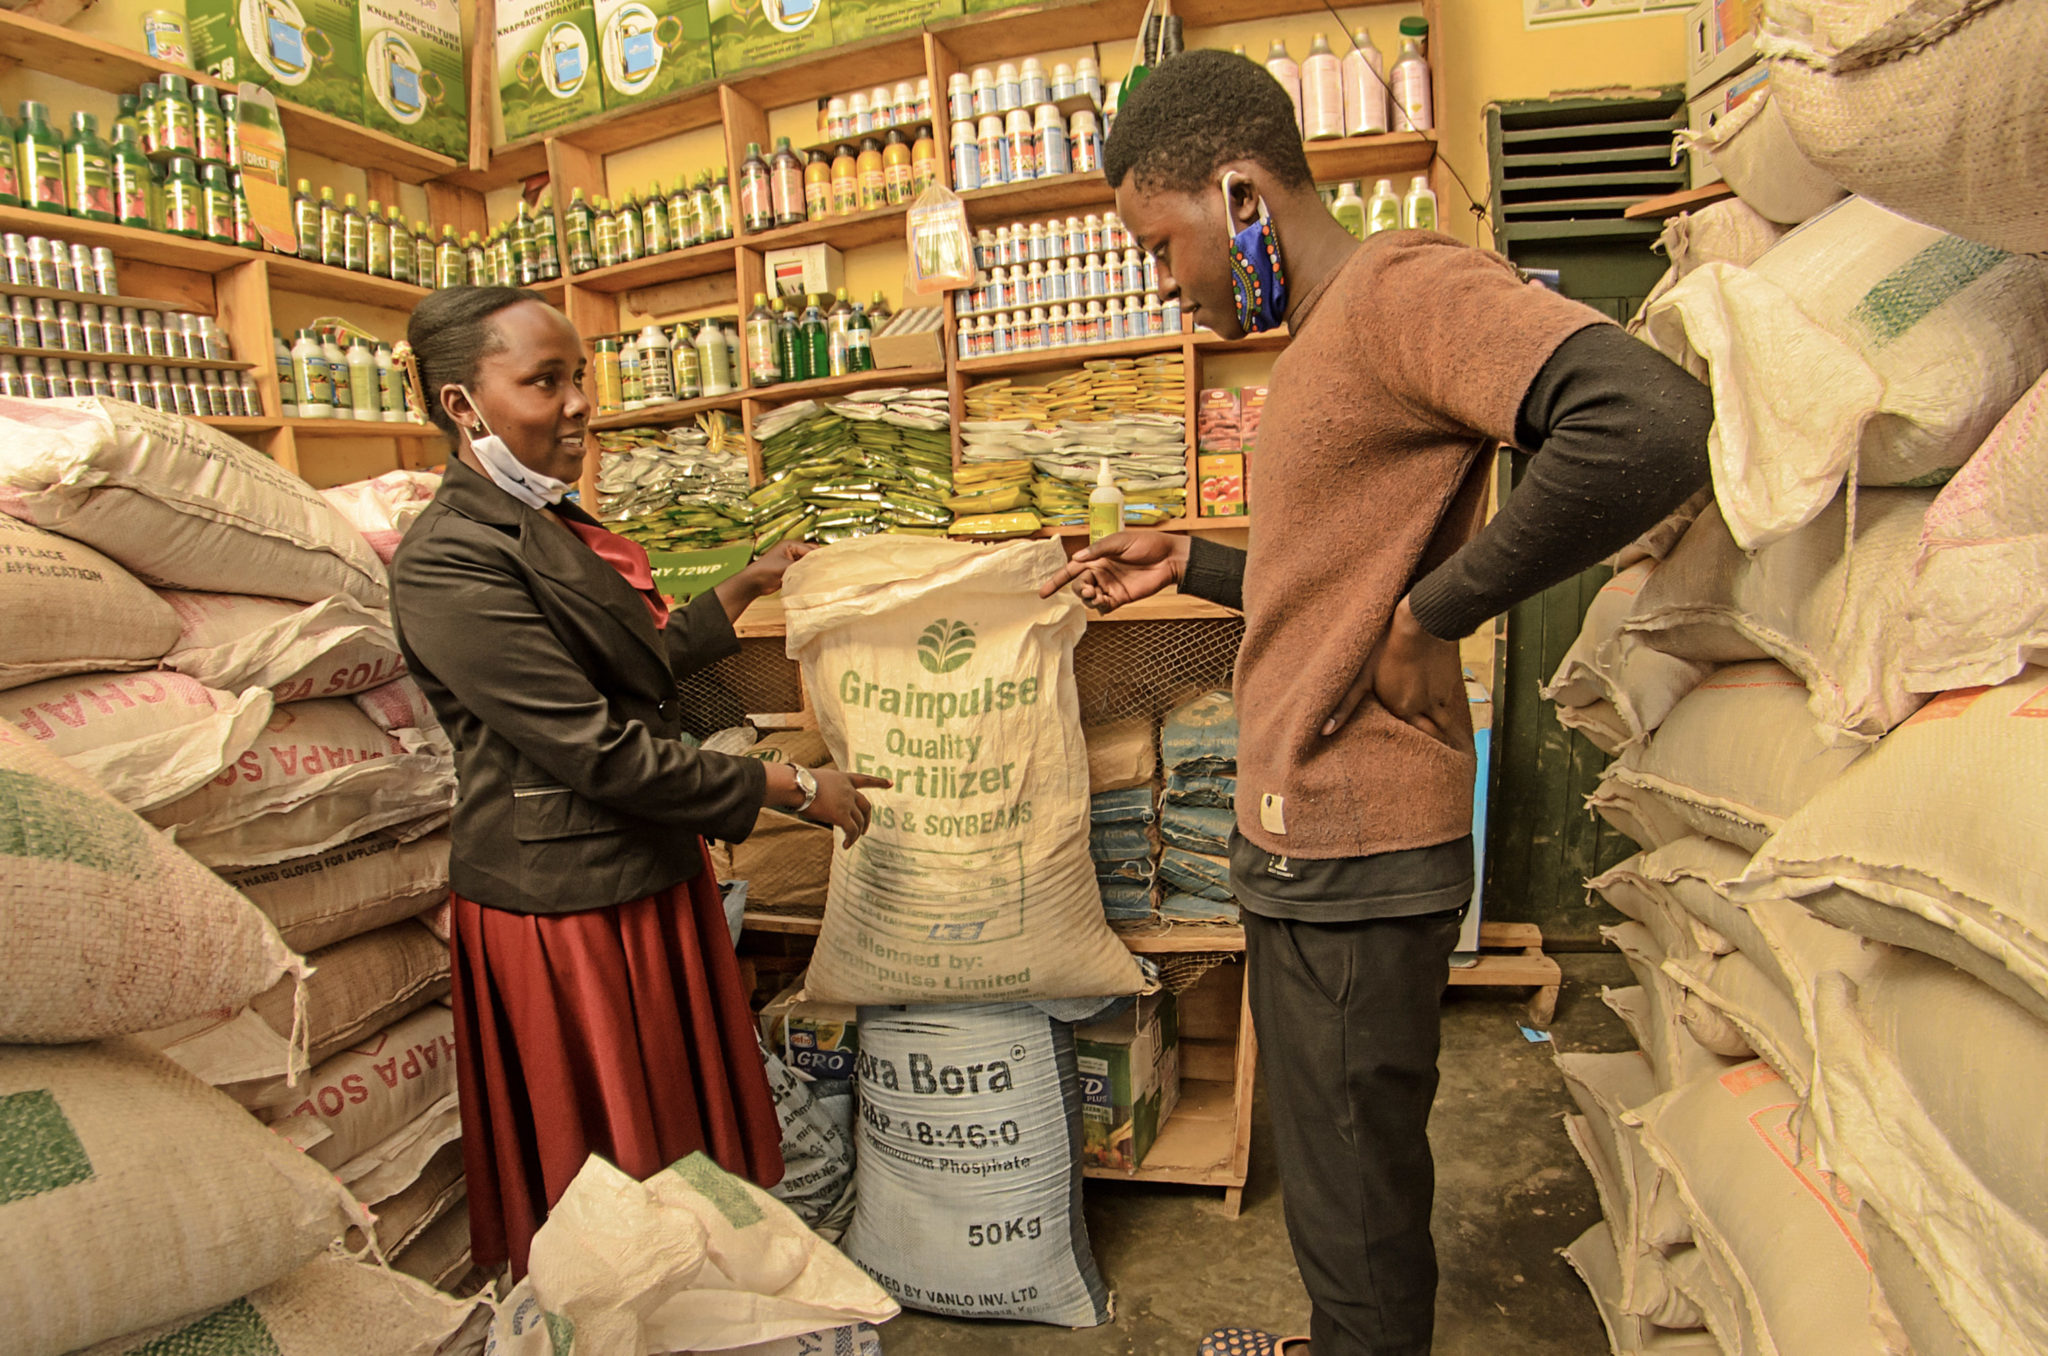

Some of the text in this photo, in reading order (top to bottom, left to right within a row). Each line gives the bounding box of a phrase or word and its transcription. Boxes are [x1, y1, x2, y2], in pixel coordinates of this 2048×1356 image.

[523, 0, 581, 18] AGRICUL
[366, 4, 461, 53] KNAPSACK SPRAYER
[398, 9, 459, 43] AGRICULTURE
[497, 14, 542, 37] KNAPSACK
[677, 563, 722, 577] 72WP
[839, 669, 1039, 728] Grainpulse
[886, 728, 983, 764] Quality
[901, 811, 917, 833] &
[923, 801, 1033, 838] SOYBEANS
[244, 872, 280, 888] HAND
[281, 861, 323, 880] GLOVES
[325, 854, 346, 869] FOR
[944, 967, 1031, 991] Limited
[791, 1050, 844, 1070] GRO
[939, 1155, 1031, 1178] Phosphate
[783, 1170, 821, 1193] BATCH
[968, 1215, 1042, 1248] 50Kg
[903, 1283, 922, 1299] BY
[926, 1290, 975, 1307] VANLO
[979, 1292, 1008, 1307] INV.
[1011, 1286, 1039, 1304] LTD
